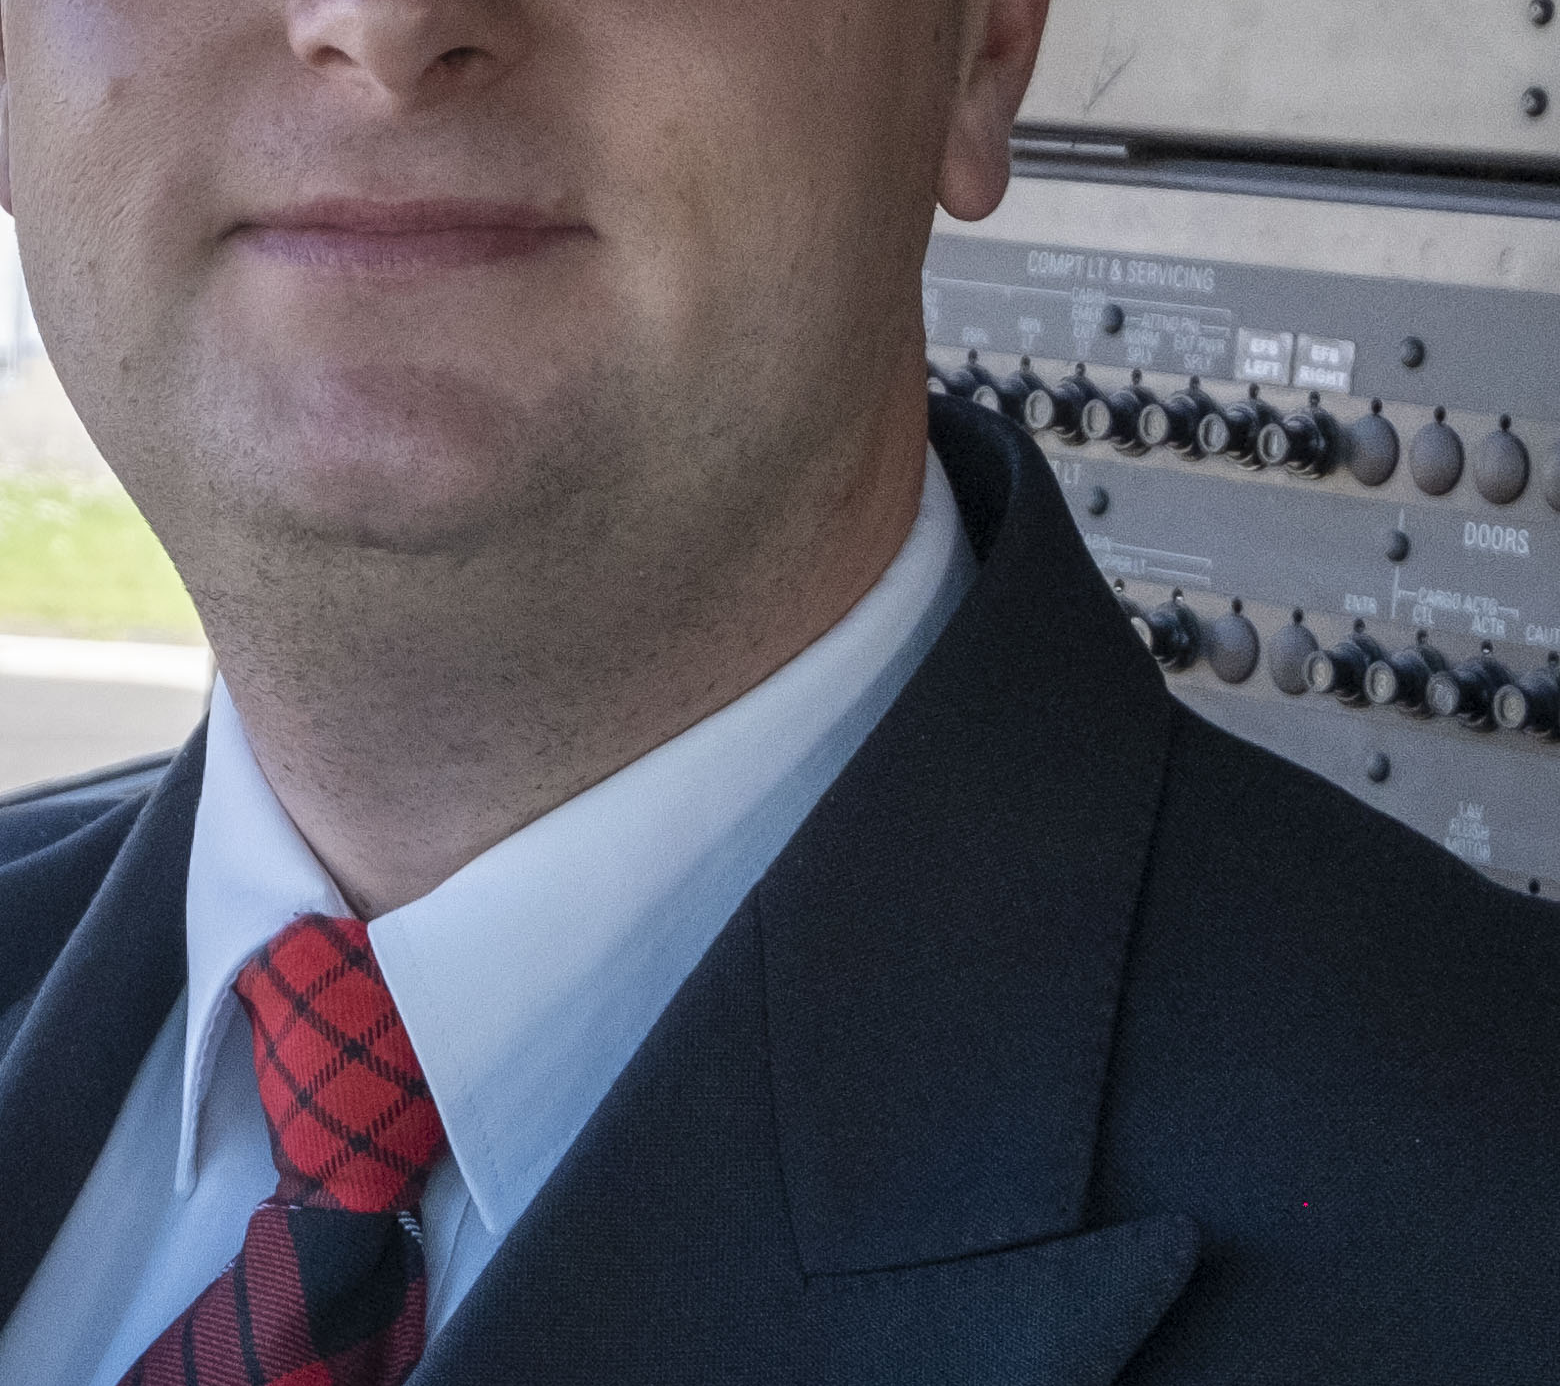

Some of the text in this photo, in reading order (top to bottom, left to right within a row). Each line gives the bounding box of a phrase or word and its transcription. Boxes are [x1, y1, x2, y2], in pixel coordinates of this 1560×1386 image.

[1027, 250, 1216, 294] COMPT LT & SERVICING
[1463, 521, 1530, 556] DOORS
